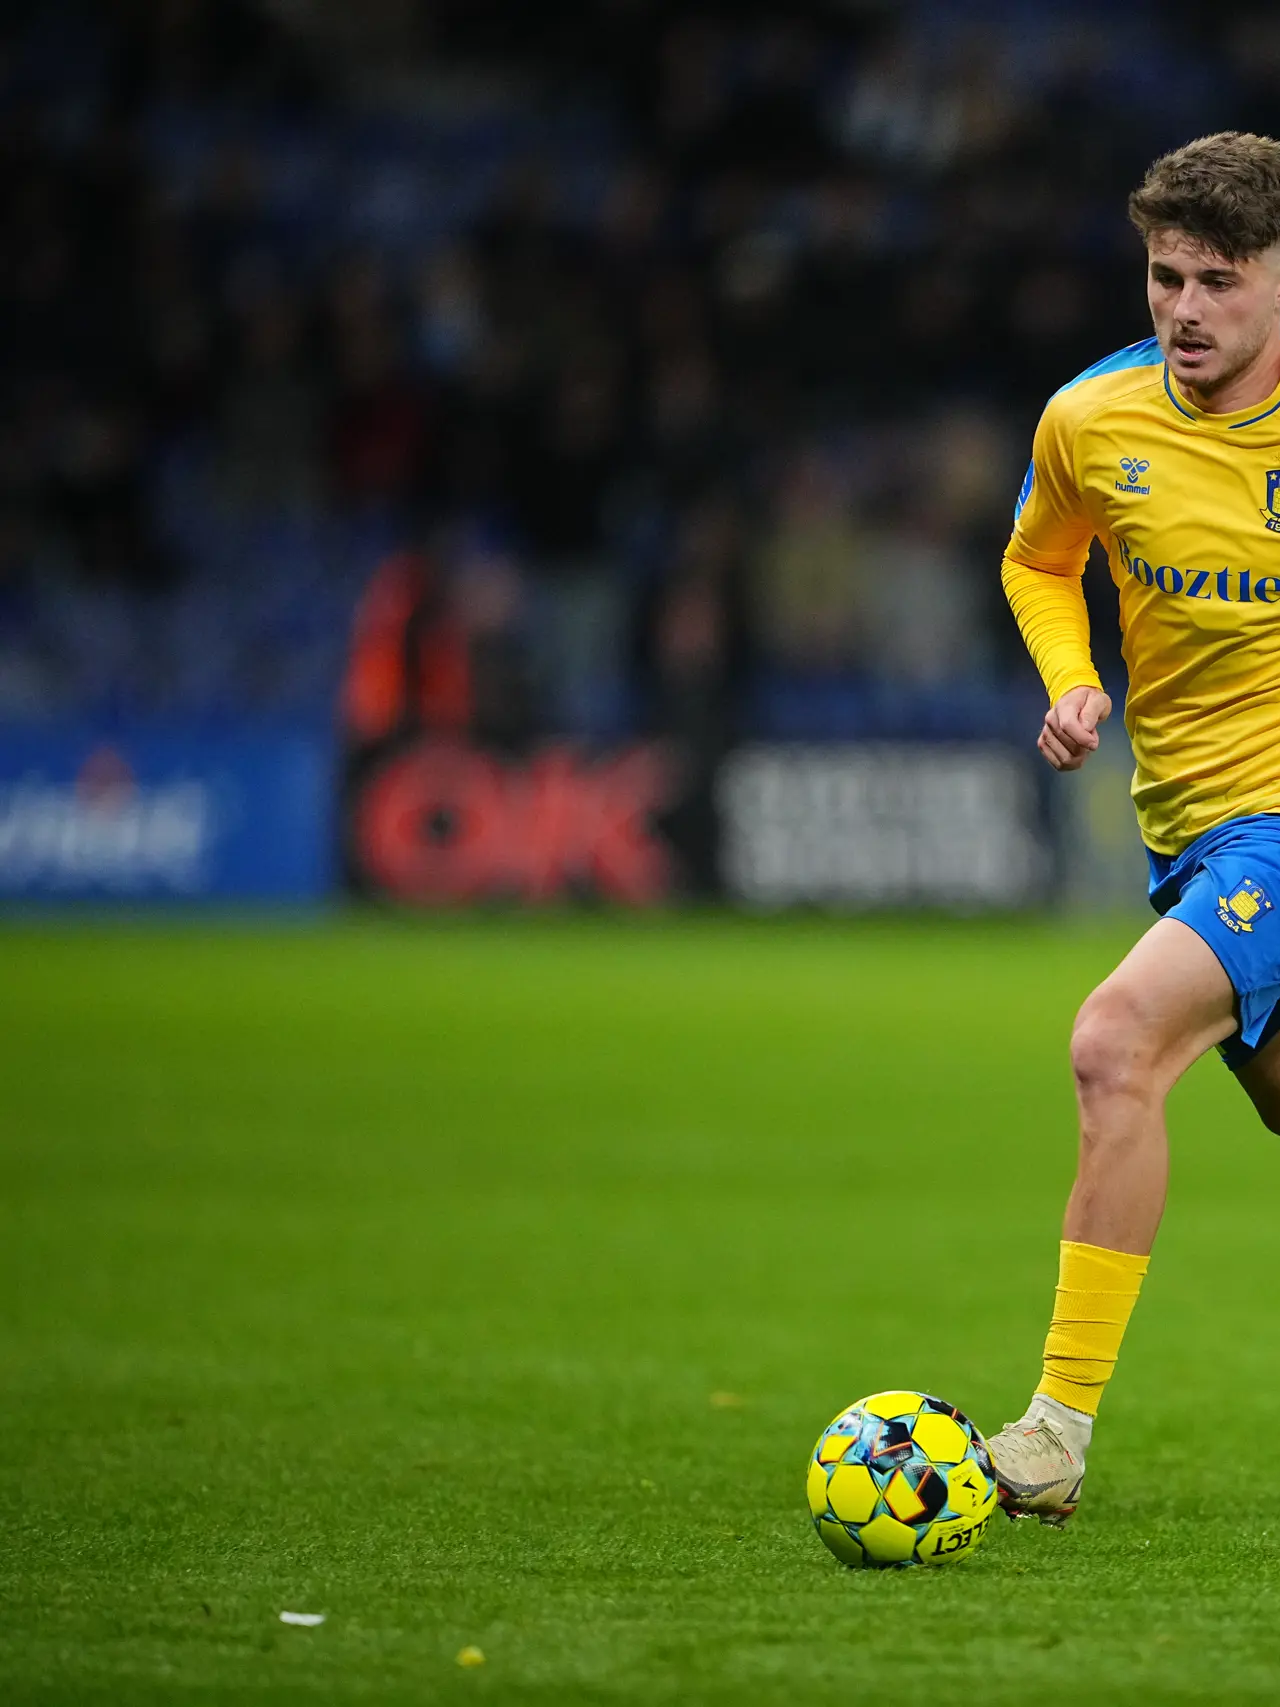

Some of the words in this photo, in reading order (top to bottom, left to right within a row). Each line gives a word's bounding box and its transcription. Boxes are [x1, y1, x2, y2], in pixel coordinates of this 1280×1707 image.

[1115, 480, 1150, 495] hummel
[360, 746, 672, 906] OK
[1217, 908, 1240, 933] 1964
